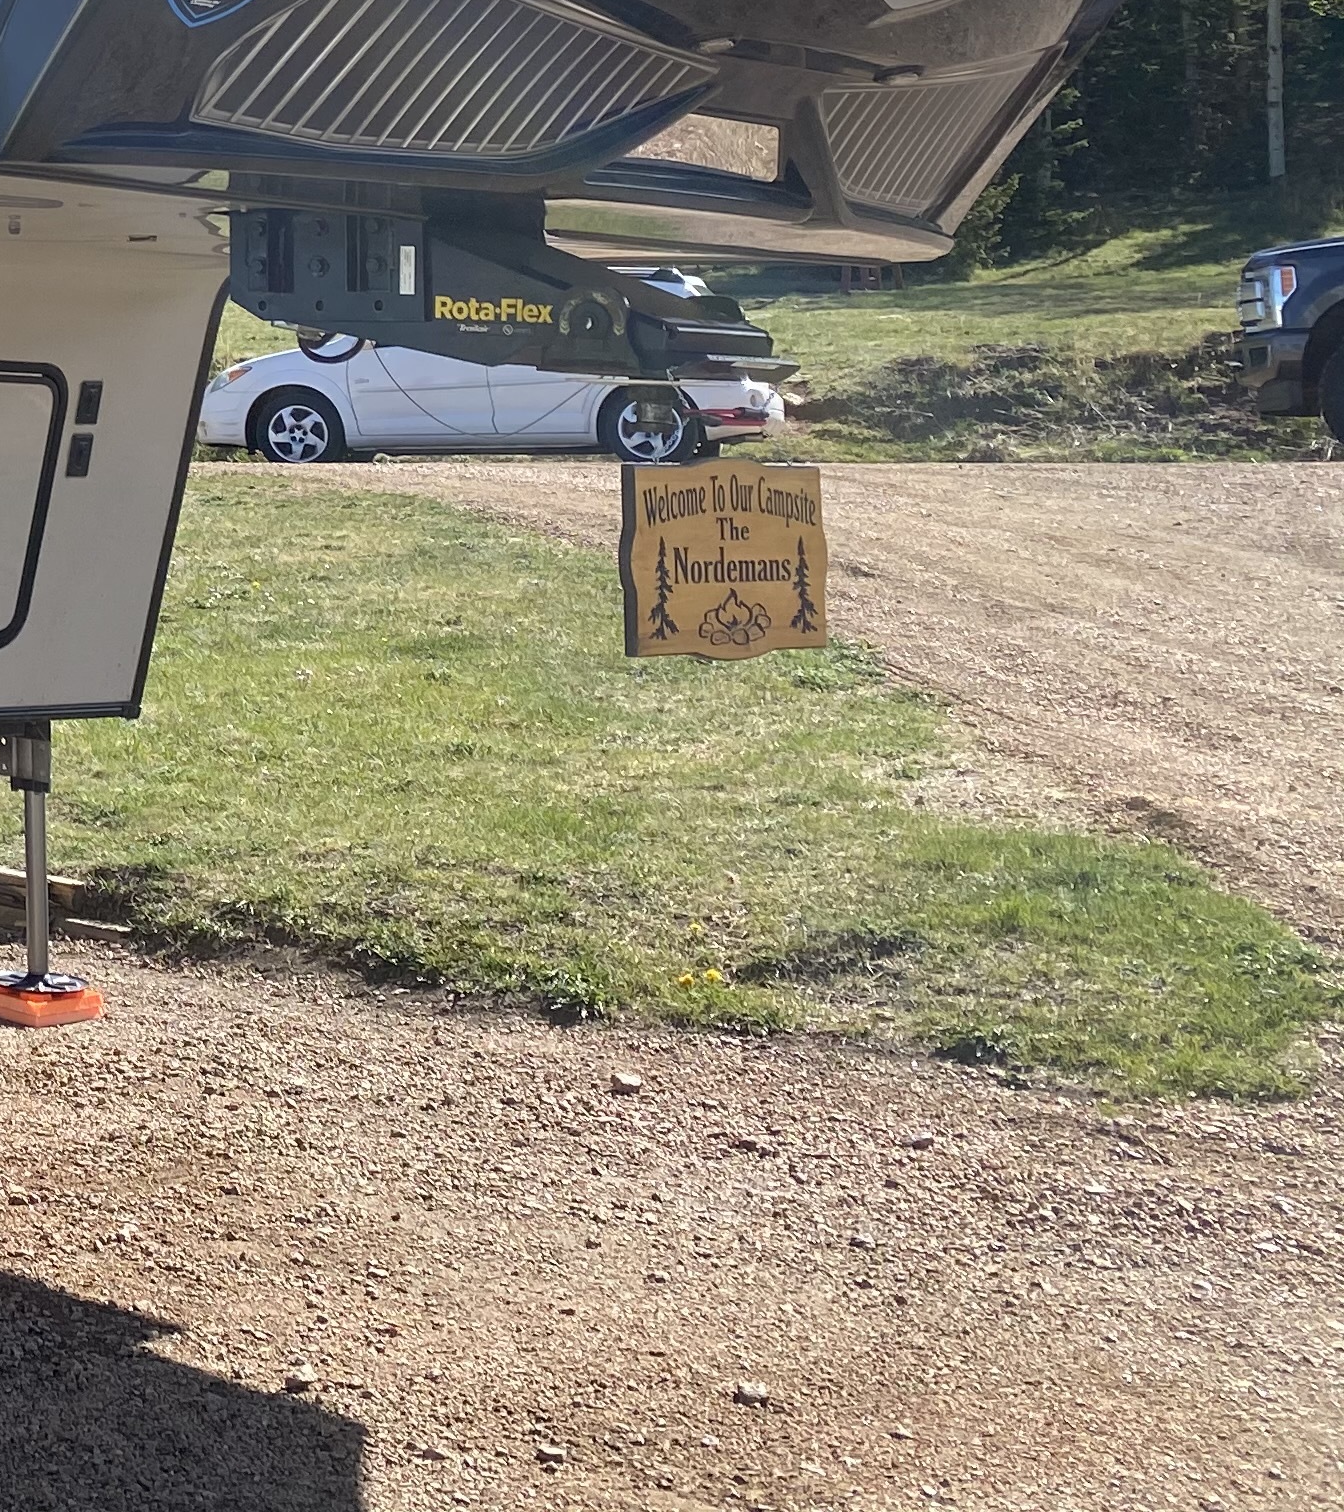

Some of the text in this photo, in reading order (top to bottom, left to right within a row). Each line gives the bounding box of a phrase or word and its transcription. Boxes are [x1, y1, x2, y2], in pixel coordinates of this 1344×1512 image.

[643, 474, 817, 528] Welcome To Our Campsite
[716, 517, 750, 541] The
[673, 546, 792, 585] Nordemans
